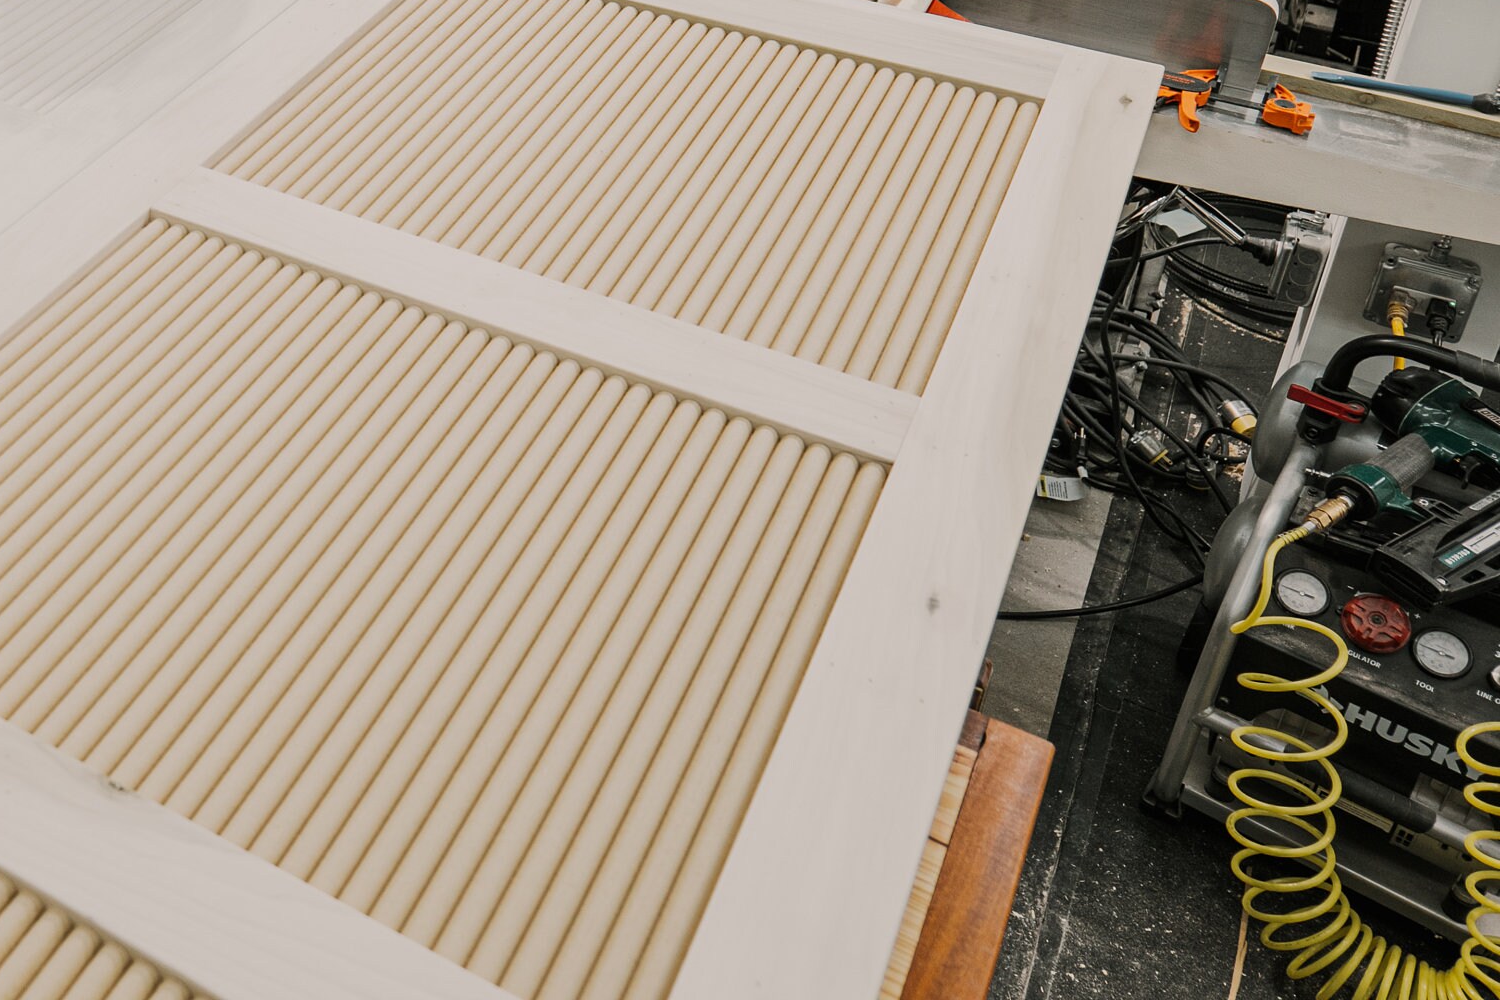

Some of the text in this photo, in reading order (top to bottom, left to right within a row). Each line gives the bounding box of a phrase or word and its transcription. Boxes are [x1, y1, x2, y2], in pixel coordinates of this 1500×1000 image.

[1347, 649, 1382, 669] GULATOR
[1415, 679, 1435, 693] TOOL
[1476, 689, 1493, 701] LINE
